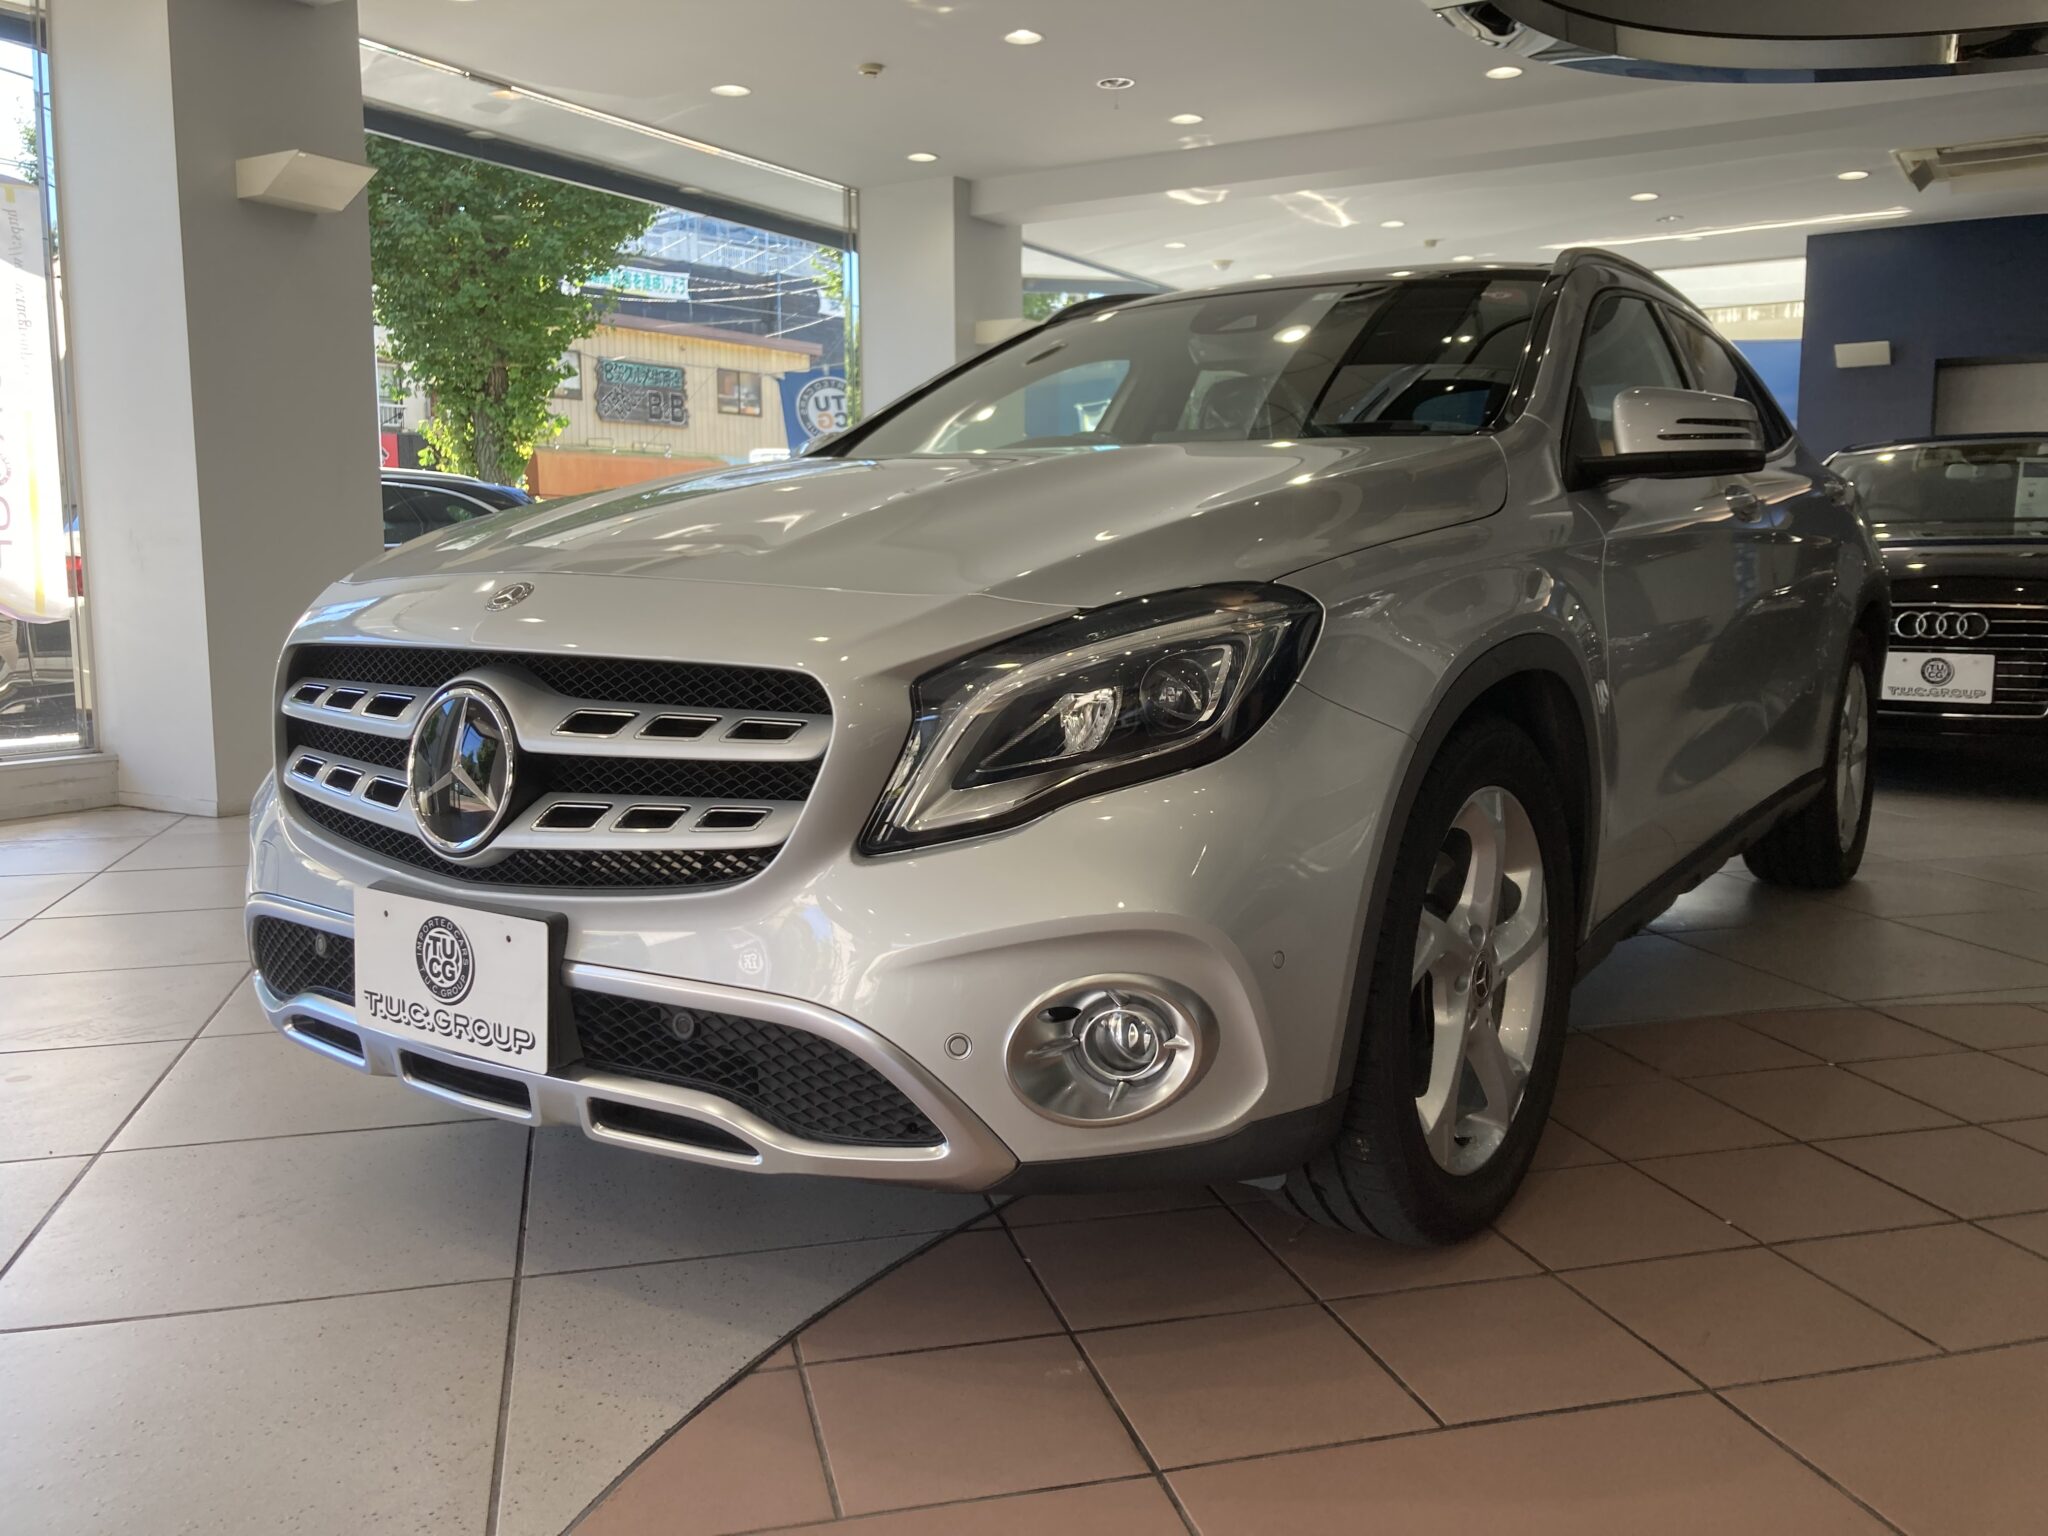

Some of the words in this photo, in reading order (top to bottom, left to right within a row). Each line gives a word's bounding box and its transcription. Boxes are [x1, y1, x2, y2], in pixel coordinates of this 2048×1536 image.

[416, 918, 453, 956] IMPORTED
[453, 929, 469, 966] CARS
[364, 990, 536, 1055] T.U.C.GROUP
